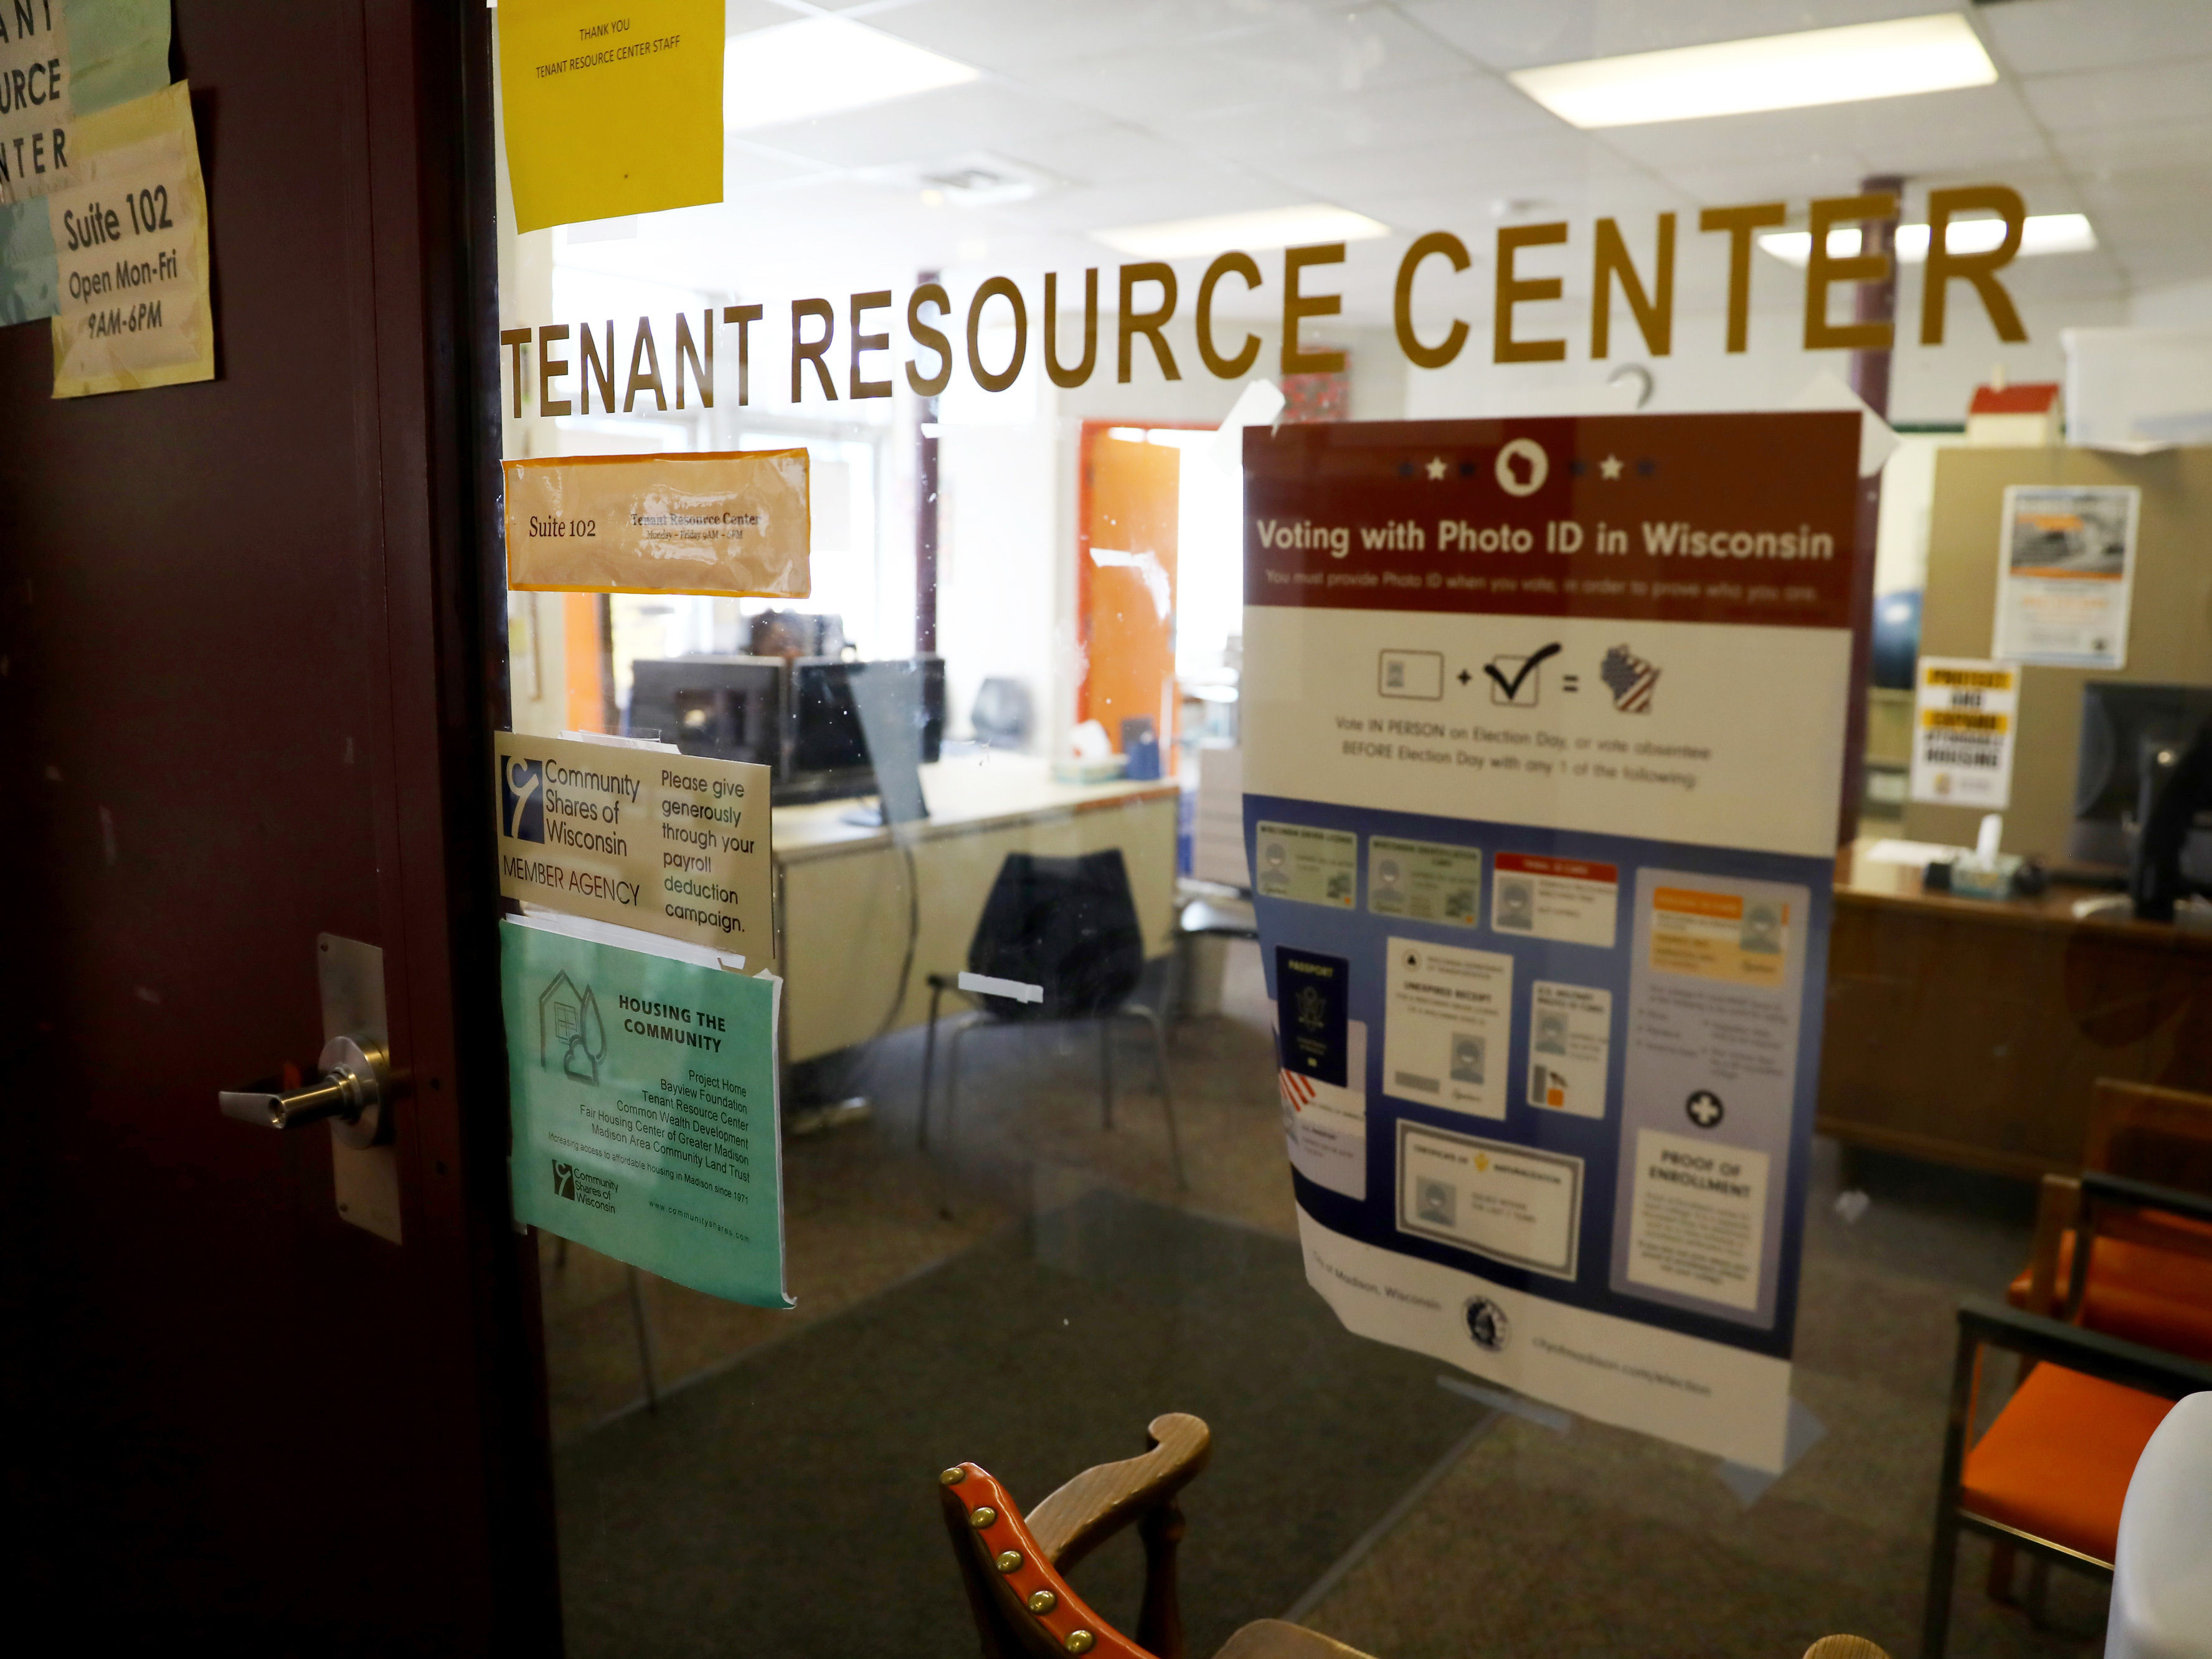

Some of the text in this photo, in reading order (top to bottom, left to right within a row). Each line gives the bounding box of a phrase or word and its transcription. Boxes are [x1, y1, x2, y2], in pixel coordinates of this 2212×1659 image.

[580, 18, 630, 40] THANK YOU
[536, 35, 681, 78] TENANT RESOURCE CENTER STAFF
[64, 184, 173, 252] Suite 102
[69, 249, 178, 303] Open Mon-Fri
[500, 184, 2030, 418] TENANT RESOURCE CENTER
[88, 301, 163, 340] 9AM-6PM
[529, 515, 596, 538] Suite 102
[631, 512, 762, 526] Tenant Resource Center
[646, 530, 672, 541] Monday
[680, 530, 701, 541] Friday
[1256, 519, 1835, 560] Voting with Photo ID in Wisconsin
[1266, 569, 1290, 585] You
[1336, 717, 1364, 732] Vote
[1387, 718, 1445, 739] PERSON
[545, 759, 640, 803] Community
[661, 770, 744, 800] Please give
[546, 788, 619, 825] Shares of
[662, 799, 741, 828] generously
[546, 818, 627, 857] Wisconsin
[662, 823, 754, 854] through your
[663, 851, 711, 873] payroll
[503, 855, 640, 907] MEMBER AGENCY
[664, 876, 738, 905] deduction
[665, 903, 745, 933] campaign.
[619, 995, 726, 1032] HOUSING THE
[624, 1018, 721, 1053] COMMUNITY
[661, 1079, 747, 1114] Bayview Foundation
[689, 1069, 747, 1097] Project Home
[617, 1100, 748, 1150] Common Wealth Development
[642, 1090, 749, 1132] Tenant Resource Center
[580, 1104, 749, 1166] Fair Housing Center of Greater Madison
[548, 1132, 748, 1205] Increasing access to affordable housing in Madison since 1971
[592, 1123, 750, 1183] Madison Area Community Land Trust
[1661, 1149, 1714, 1171] PROOF
[574, 1168, 618, 1193] Community
[575, 1180, 611, 1201] Shares of
[576, 1192, 615, 1214] Wisconsin
